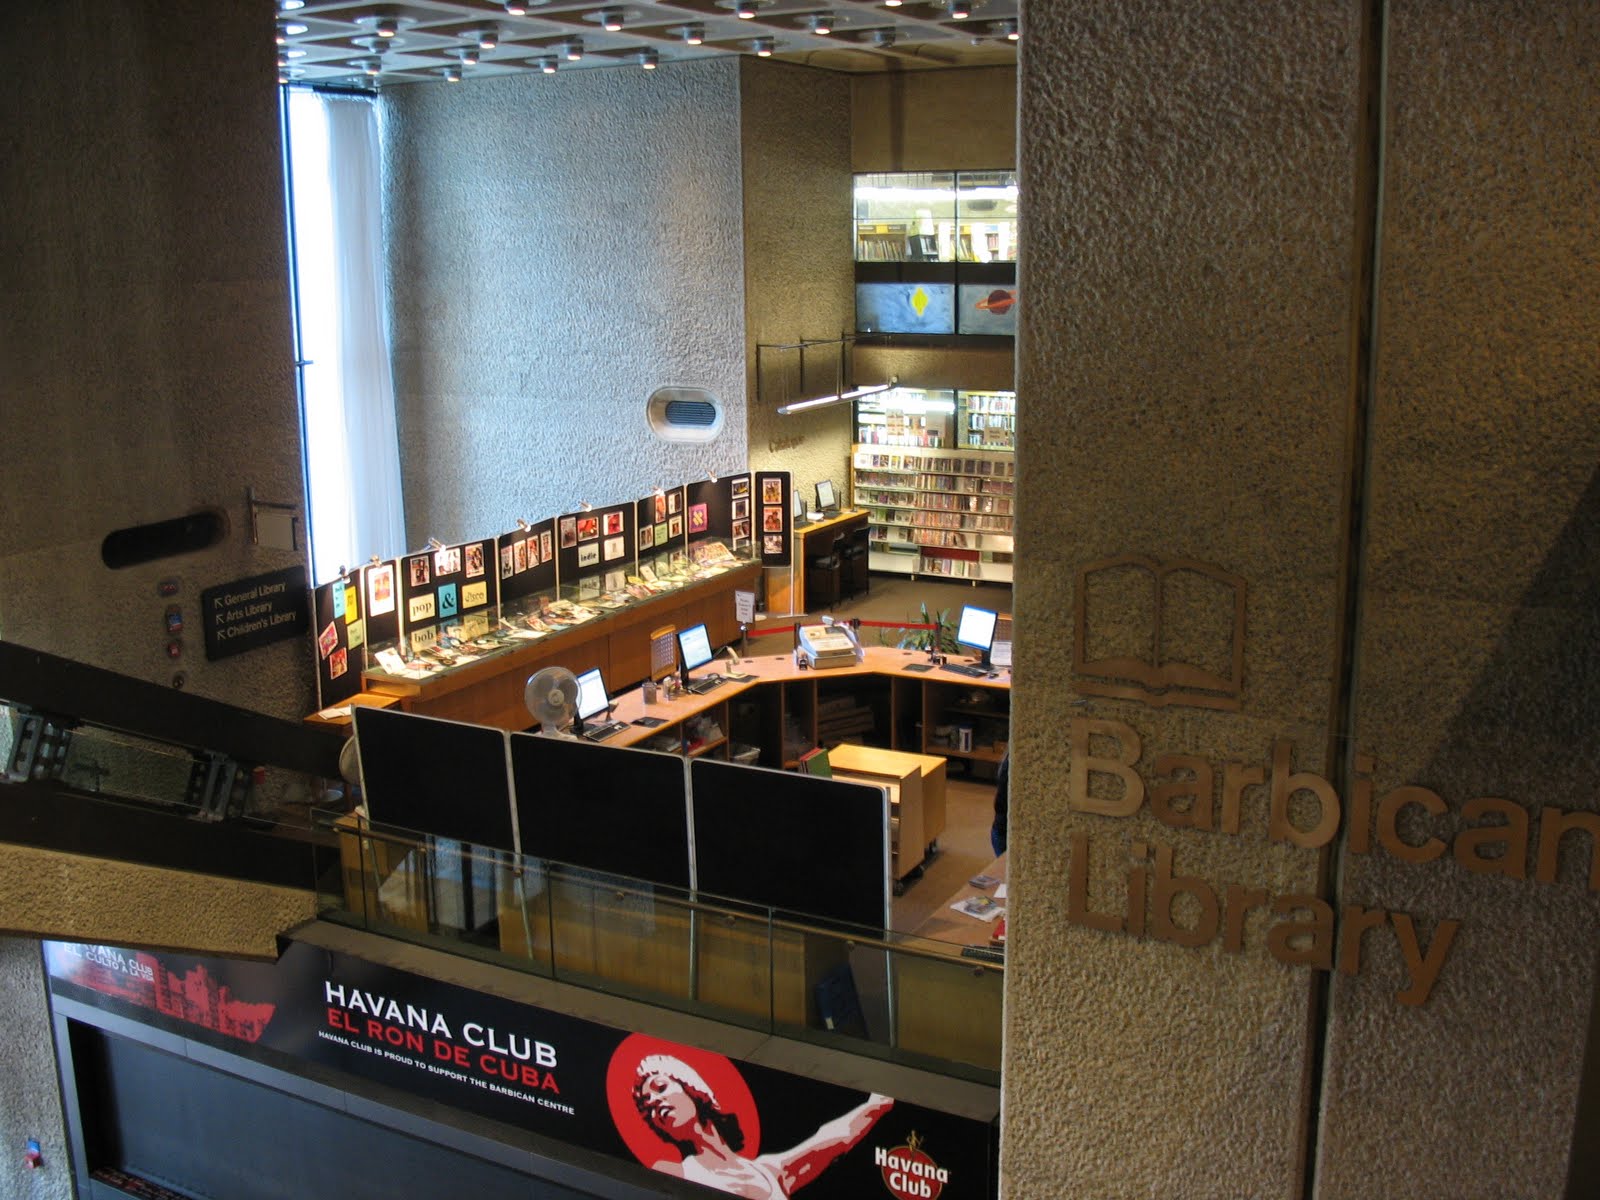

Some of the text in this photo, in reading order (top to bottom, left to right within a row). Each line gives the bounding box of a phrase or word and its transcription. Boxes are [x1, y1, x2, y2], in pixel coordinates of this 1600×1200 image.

[224, 583, 286, 605] General Library
[413, 602, 432, 616] pop
[442, 593, 455, 609] &
[226, 602, 272, 621] Arts Library
[227, 611, 296, 637] Children's Library
[1069, 718, 1600, 893] Barbican
[1067, 832, 1459, 1006] Library
[86, 951, 119, 969] CULTO
[129, 959, 153, 976] CLUB
[325, 981, 557, 1068] HAVANA CLUB
[327, 1007, 560, 1094] EL RON DE CUBA
[318, 1030, 575, 1115] HAVANA CLUB IS PROUD TO SUPPORT THE BARBICAN CENTRE
[875, 1147, 948, 1183] Havana
[890, 1172, 931, 1198] Club
